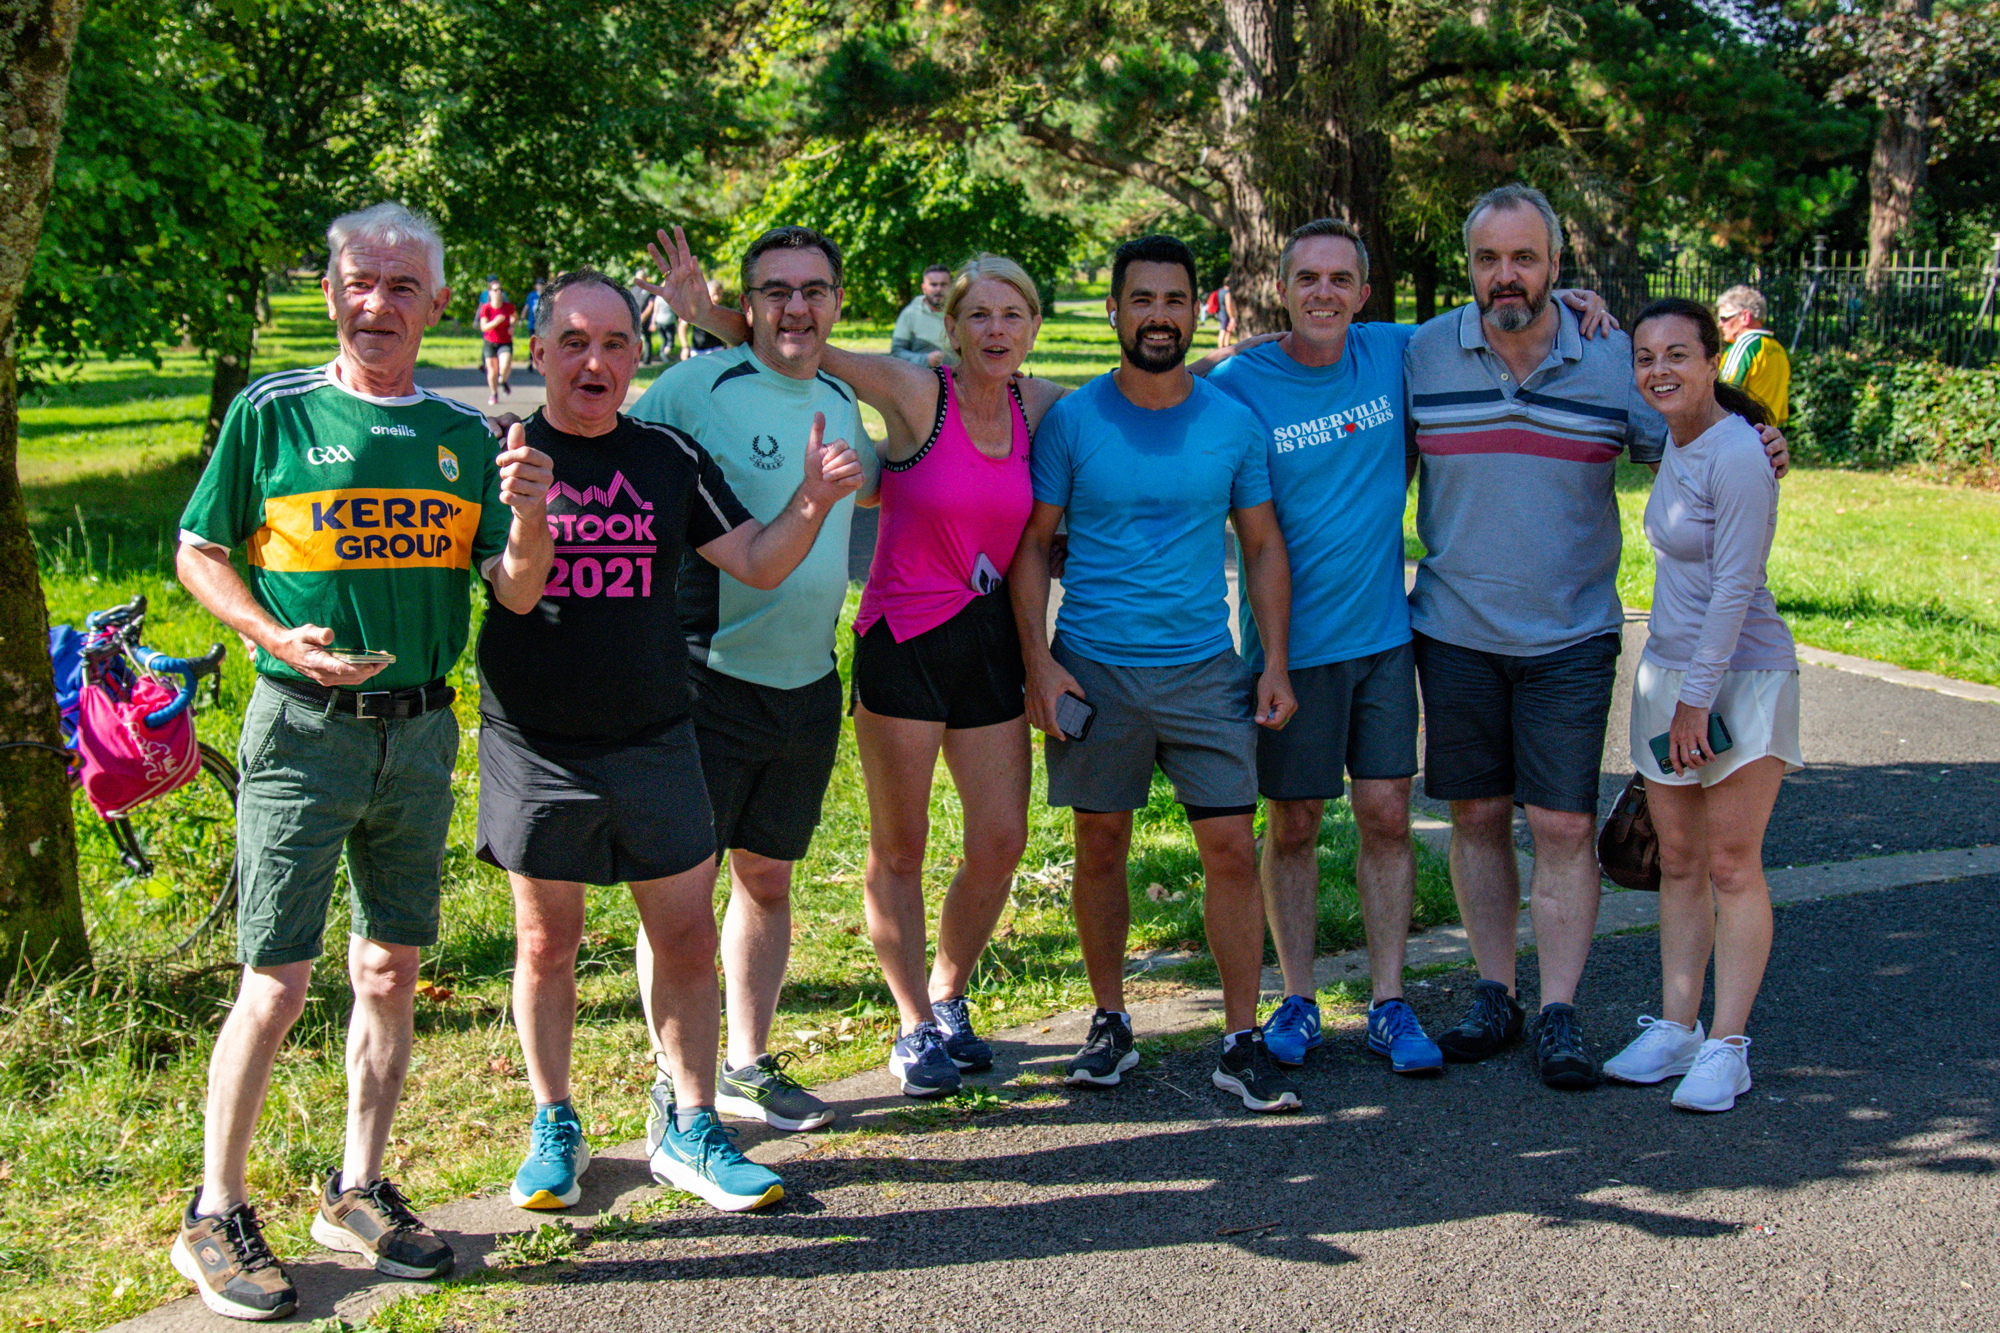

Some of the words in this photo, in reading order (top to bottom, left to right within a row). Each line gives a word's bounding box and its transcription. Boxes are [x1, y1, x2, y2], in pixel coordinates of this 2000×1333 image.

[1272, 394, 1391, 442] SOMERVILLE
[1275, 440, 1295, 454] IS
[1296, 430, 1333, 449] FOR
[335, 533, 452, 560] GROUP
[542, 556, 653, 598] 2021
